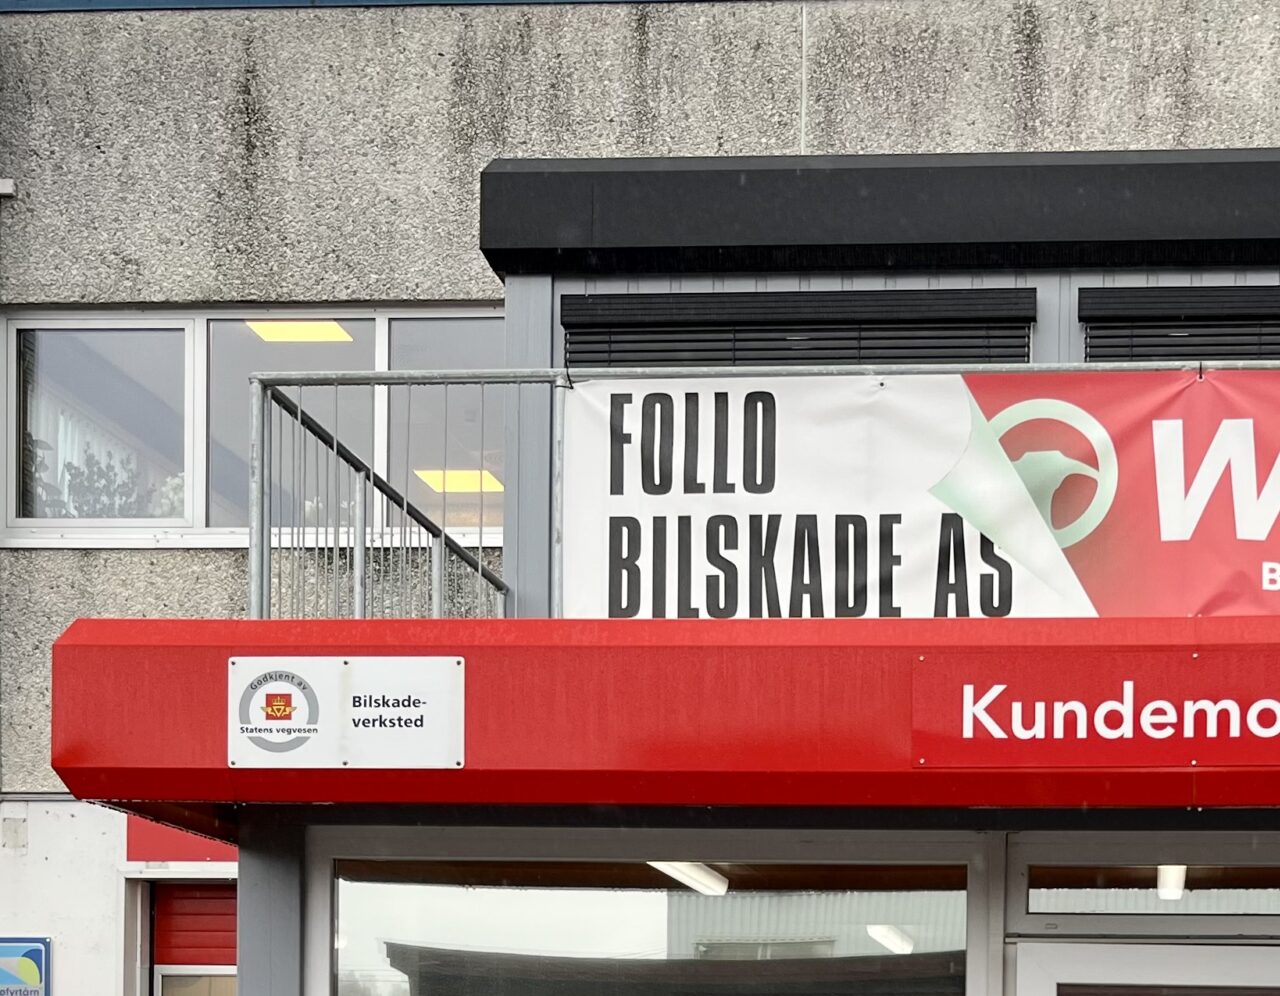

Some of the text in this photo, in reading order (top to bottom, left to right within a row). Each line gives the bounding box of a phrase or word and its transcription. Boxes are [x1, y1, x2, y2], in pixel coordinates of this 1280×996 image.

[609, 391, 776, 495] FOLLO
[608, 513, 1013, 619] BILSKADE AS
[249, 672, 309, 692] Godkjent av
[352, 695, 427, 709] Bilskade-
[351, 714, 424, 728] verksted
[240, 726, 318, 735] Statens vegvesen
